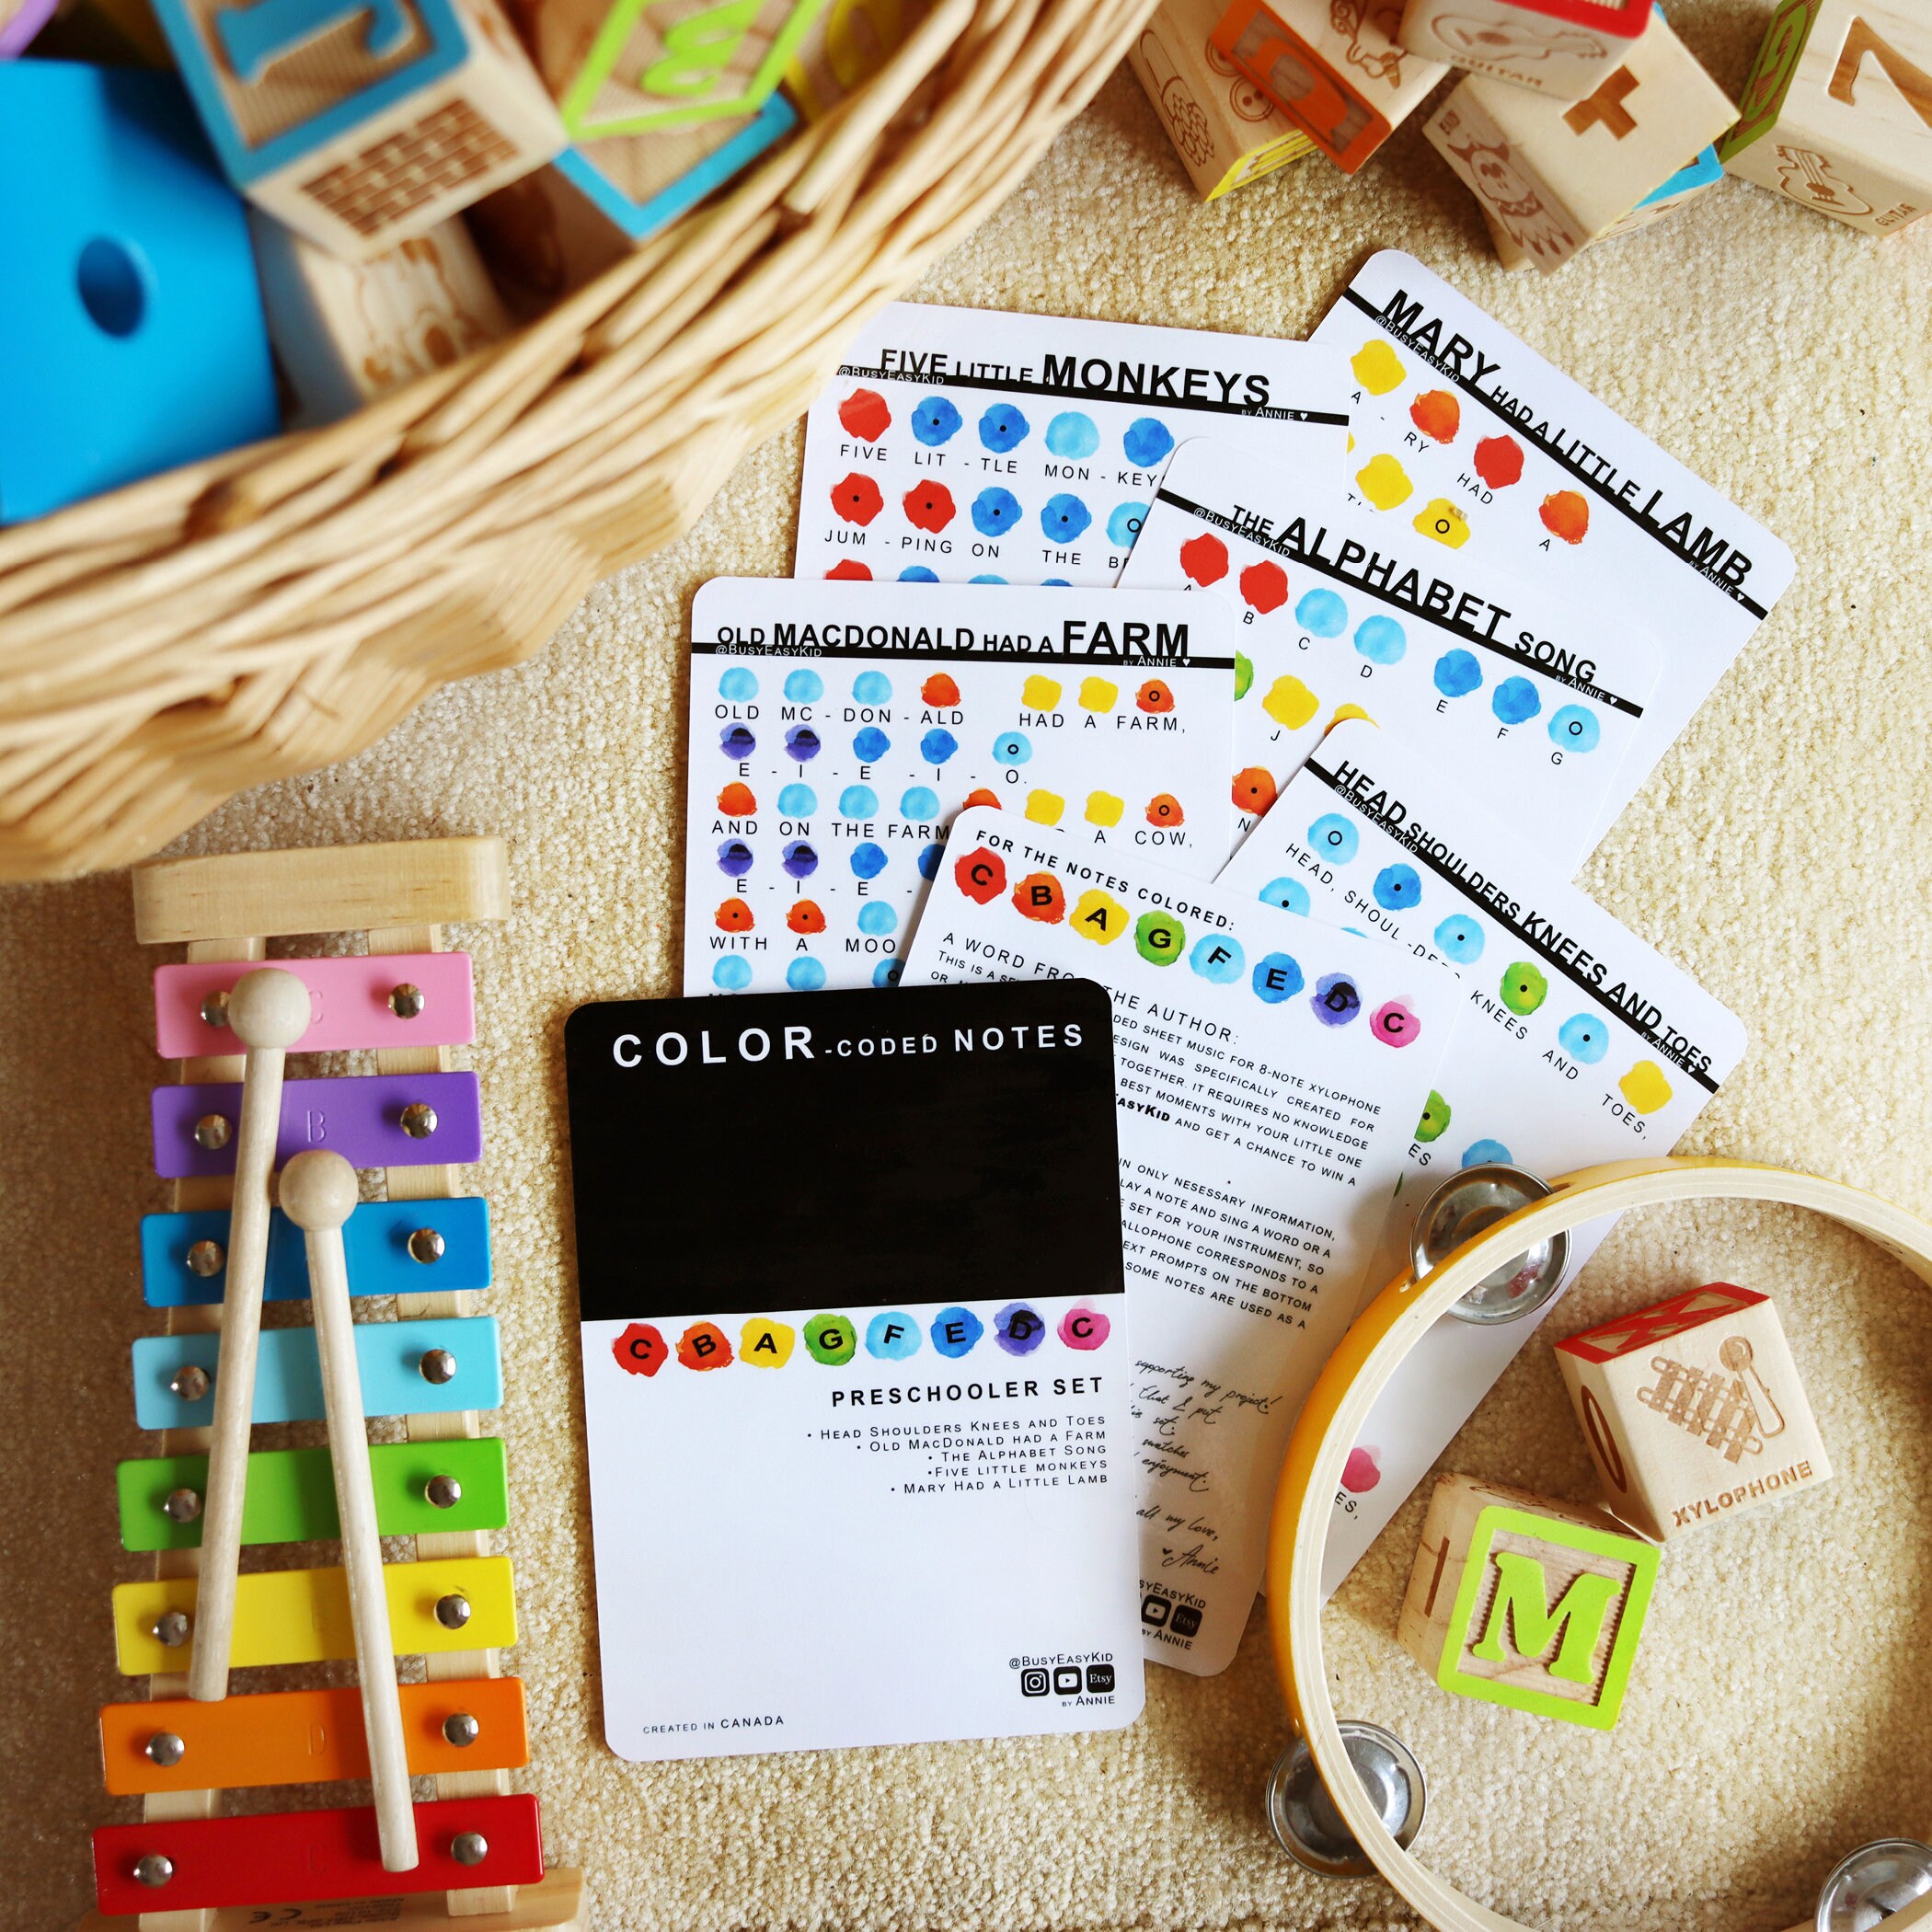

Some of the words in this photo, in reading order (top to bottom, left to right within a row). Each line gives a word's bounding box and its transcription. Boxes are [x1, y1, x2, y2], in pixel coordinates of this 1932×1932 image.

[1874, 202, 1917, 227] GUITAR
[880, 349, 948, 376] FIVE
[956, 361, 1033, 384] LITTLE
[1042, 353, 1271, 408] MONKEYS
[1254, 406, 1295, 421] ANNIE
[840, 443, 888, 462] FIVE
[1381, 289, 1501, 385] MARY
[1490, 385, 1534, 425] HAD
[1533, 421, 1550, 440] A
[1550, 428, 1641, 506] LITTLE
[1639, 489, 1753, 587] LAMB
[1456, 473, 1494, 505] HAD
[972, 543, 999, 558] ON
[1041, 549, 1082, 566] THE
[1229, 504, 1275, 539] THE
[1276, 516, 1512, 640] ALPHABET
[1514, 631, 1597, 684] SONG
[1699, 565, 1734, 596] ANNIE
[717, 627, 765, 646] OLD
[773, 623, 975, 652] MACDONALD
[983, 634, 1032, 653] HAD
[1037, 635, 1055, 654] A
[1063, 620, 1189, 658] FARM
[1136, 656, 1178, 668] ANNIE
[1242, 611, 1255, 626] B
[1298, 637, 1311, 650] C
[1360, 664, 1374, 679] D
[1435, 699, 1448, 714] E
[1496, 727, 1509, 740] F
[1550, 751, 1564, 765] G
[1567, 677, 1606, 702] ANNIE
[715, 704, 760, 720] OLD
[1019, 712, 1064, 728] HAD
[1084, 714, 1097, 729] A
[711, 820, 758, 835] AND
[779, 821, 810, 836] ON
[831, 822, 875, 838] THE
[888, 823, 950, 840] FARM
[1095, 829, 1107, 845] A
[976, 830, 1015, 853] FOR
[1023, 845, 1059, 868] THE
[1065, 861, 1130, 893] NOTES
[1333, 760, 1407, 825] HEAD
[1405, 822, 1522, 920] SHOULDERS
[1520, 910, 1608, 985] KNEES
[1608, 982, 1662, 1030] AND
[1662, 1026, 1713, 1074] TOES
[709, 936, 767, 950] WITH
[845, 937, 896, 954] MOO
[943, 932, 955, 946] A
[966, 938, 1026, 970] WORD
[971, 864, 994, 887] C
[1030, 885, 1052, 906] B
[1085, 907, 1107, 931] A
[1149, 928, 1172, 949] G
[1207, 946, 1232, 967] F
[1265, 968, 1288, 991] E
[1324, 988, 1348, 1013] D
[1383, 1012, 1404, 1033] C
[954, 1023, 1083, 1052] NOTES
[1469, 990, 1529, 1041] KNEES
[1542, 1049, 1580, 1081] AND
[1651, 1037, 1685, 1069] ANNIE
[1143, 1025, 1183, 1045] SHEET
[1186, 1040, 1225, 1060] MUSIC
[1229, 1054, 1255, 1071] FOR
[1259, 1064, 1305, 1088] 8-NOTE
[1308, 1083, 1382, 1115] XYLOPHONE
[1159, 1050, 1185, 1066] WAS
[1194, 1064, 1278, 1098] SPECIFICALLY
[1286, 1096, 1341, 1121] CREATED
[1350, 1117, 1374, 1133] FOR
[1120, 1077, 1152, 1095] BEST
[1155, 1089, 1216, 1118] MOMENTS
[1221, 1112, 1251, 1130] WITH
[1257, 1124, 1290, 1143] YOUR
[1294, 1137, 1333, 1158] LITTLE
[1337, 1153, 1363, 1168] ONE
[1191, 1082, 1205, 1093] IT
[1207, 1087, 1269, 1116] REQUIRES
[1271, 1110, 1290, 1123] NO
[1293, 1118, 1369, 1150] KNOWLEDGE
[1174, 1118, 1201, 1132] AND
[1205, 1127, 1231, 1142] GET
[1233, 1137, 1241, 1146] A
[1246, 1141, 1296, 1166] CHANCE
[1301, 1159, 1316, 1172] TO
[1321, 1167, 1344, 1182] WIN
[1347, 1177, 1356, 1187] A
[1137, 1164, 1169, 1181] ONLY
[1174, 1177, 1247, 1208] NESESSARY
[1126, 1261, 1160, 1281] SOME
[1165, 1274, 1205, 1295] NOTES
[1210, 1291, 1236, 1306] ARE
[1239, 1300, 1272, 1317] USED
[629, 1339, 652, 1360] C
[691, 1333, 717, 1358] B
[753, 1332, 778, 1354] A
[818, 1328, 844, 1351] G
[883, 1324, 905, 1345] F
[945, 1321, 967, 1344] E
[1011, 1318, 1032, 1340] D
[1071, 1317, 1094, 1339] C
[832, 1380, 1039, 1408] PRESCHOOLER
[1052, 1376, 1103, 1396] SET
[821, 1429, 862, 1441] HEAD
[869, 1423, 962, 1438] SHOULDERS
[971, 1420, 1020, 1432] KNEES
[1028, 1419, 1058, 1429] AND
[1065, 1415, 1105, 1427] TOES
[869, 1441, 901, 1453] OLD
[908, 1436, 1005, 1450] MACDONALD
[1012, 1433, 1042, 1444] HAD
[1050, 1433, 1058, 1443] A
[1065, 1430, 1106, 1442] FARM
[940, 1451, 971, 1463] THE
[978, 1447, 1056, 1461] ALPHABET
[1064, 1444, 1107, 1456] SONG
[977, 1464, 1027, 1476] LITTLE
[1036, 1459, 1108, 1472] MONKEYS
[903, 1482, 946, 1494] MARY
[954, 1480, 984, 1491] HAD
[993, 1480, 1002, 1489] A
[1008, 1477, 1059, 1489] LITTLE
[1067, 1474, 1108, 1486] LAMB
[1670, 1459, 1813, 1527] XYLOPHONE
[1471, 1550, 1623, 1685] M
[1153, 1628, 1194, 1650] ANNIE
[1088, 1673, 1112, 1686] Etsy
[1075, 1695, 1116, 1707] ANNIE
[642, 1722, 698, 1734] CREATED
[703, 1721, 715, 1731] IN
[719, 1715, 785, 1730] CANADA
